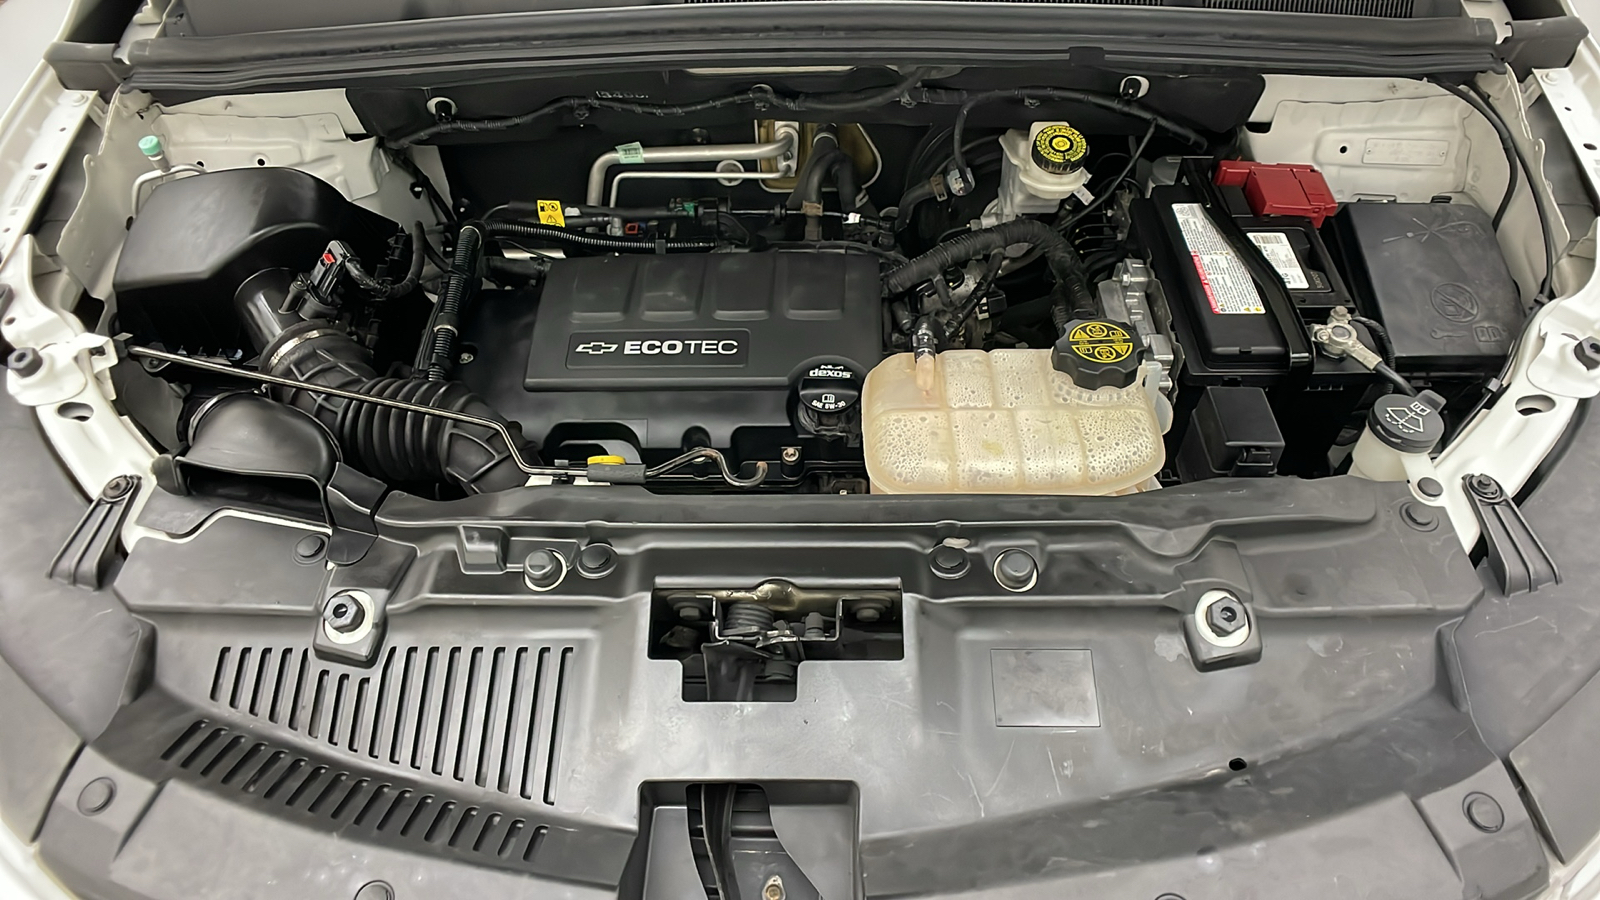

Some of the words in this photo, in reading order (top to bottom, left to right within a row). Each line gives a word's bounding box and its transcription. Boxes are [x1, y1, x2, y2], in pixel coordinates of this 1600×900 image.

[623, 339, 739, 355] ECOTEC
[809, 368, 853, 379] dexos
[811, 399, 824, 409] SAE
[824, 400, 846, 410] 5W-30
